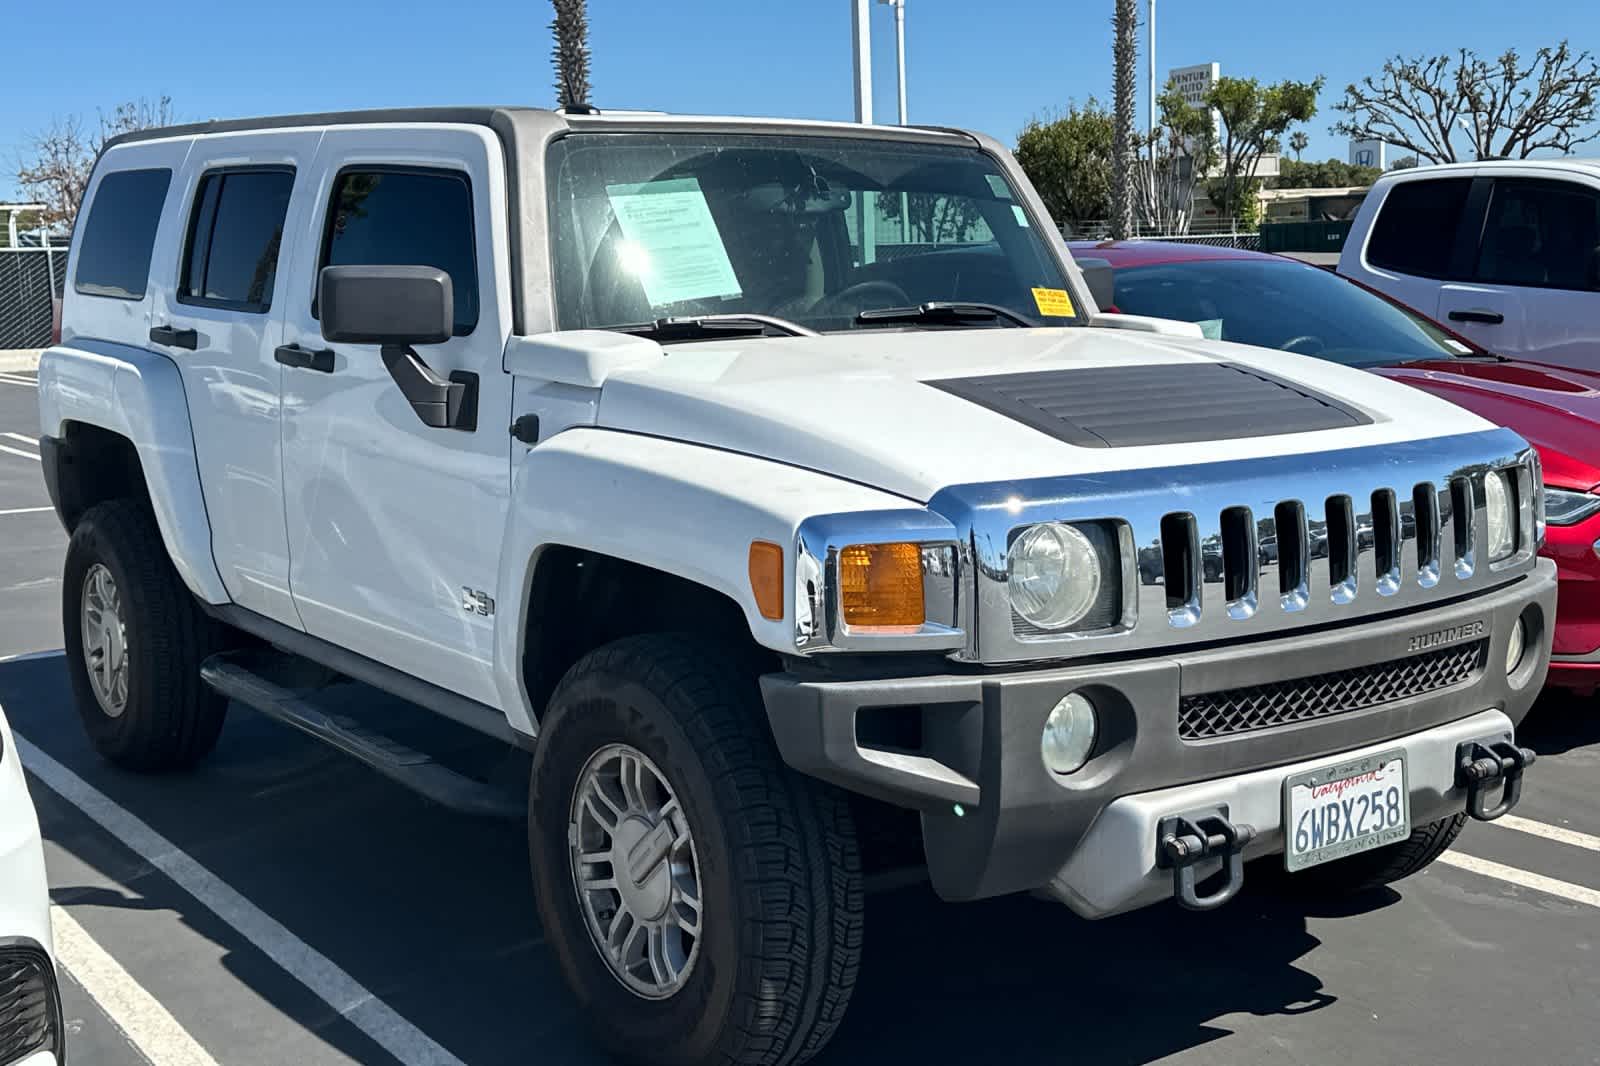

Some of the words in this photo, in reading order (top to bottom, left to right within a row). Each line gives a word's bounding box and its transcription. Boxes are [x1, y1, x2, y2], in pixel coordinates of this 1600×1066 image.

[1170, 71, 1210, 83] VENTURA
[1180, 81, 1203, 93] AUTO
[1407, 620, 1483, 652] HUMMER
[1295, 786, 1400, 853] 6WBX258
